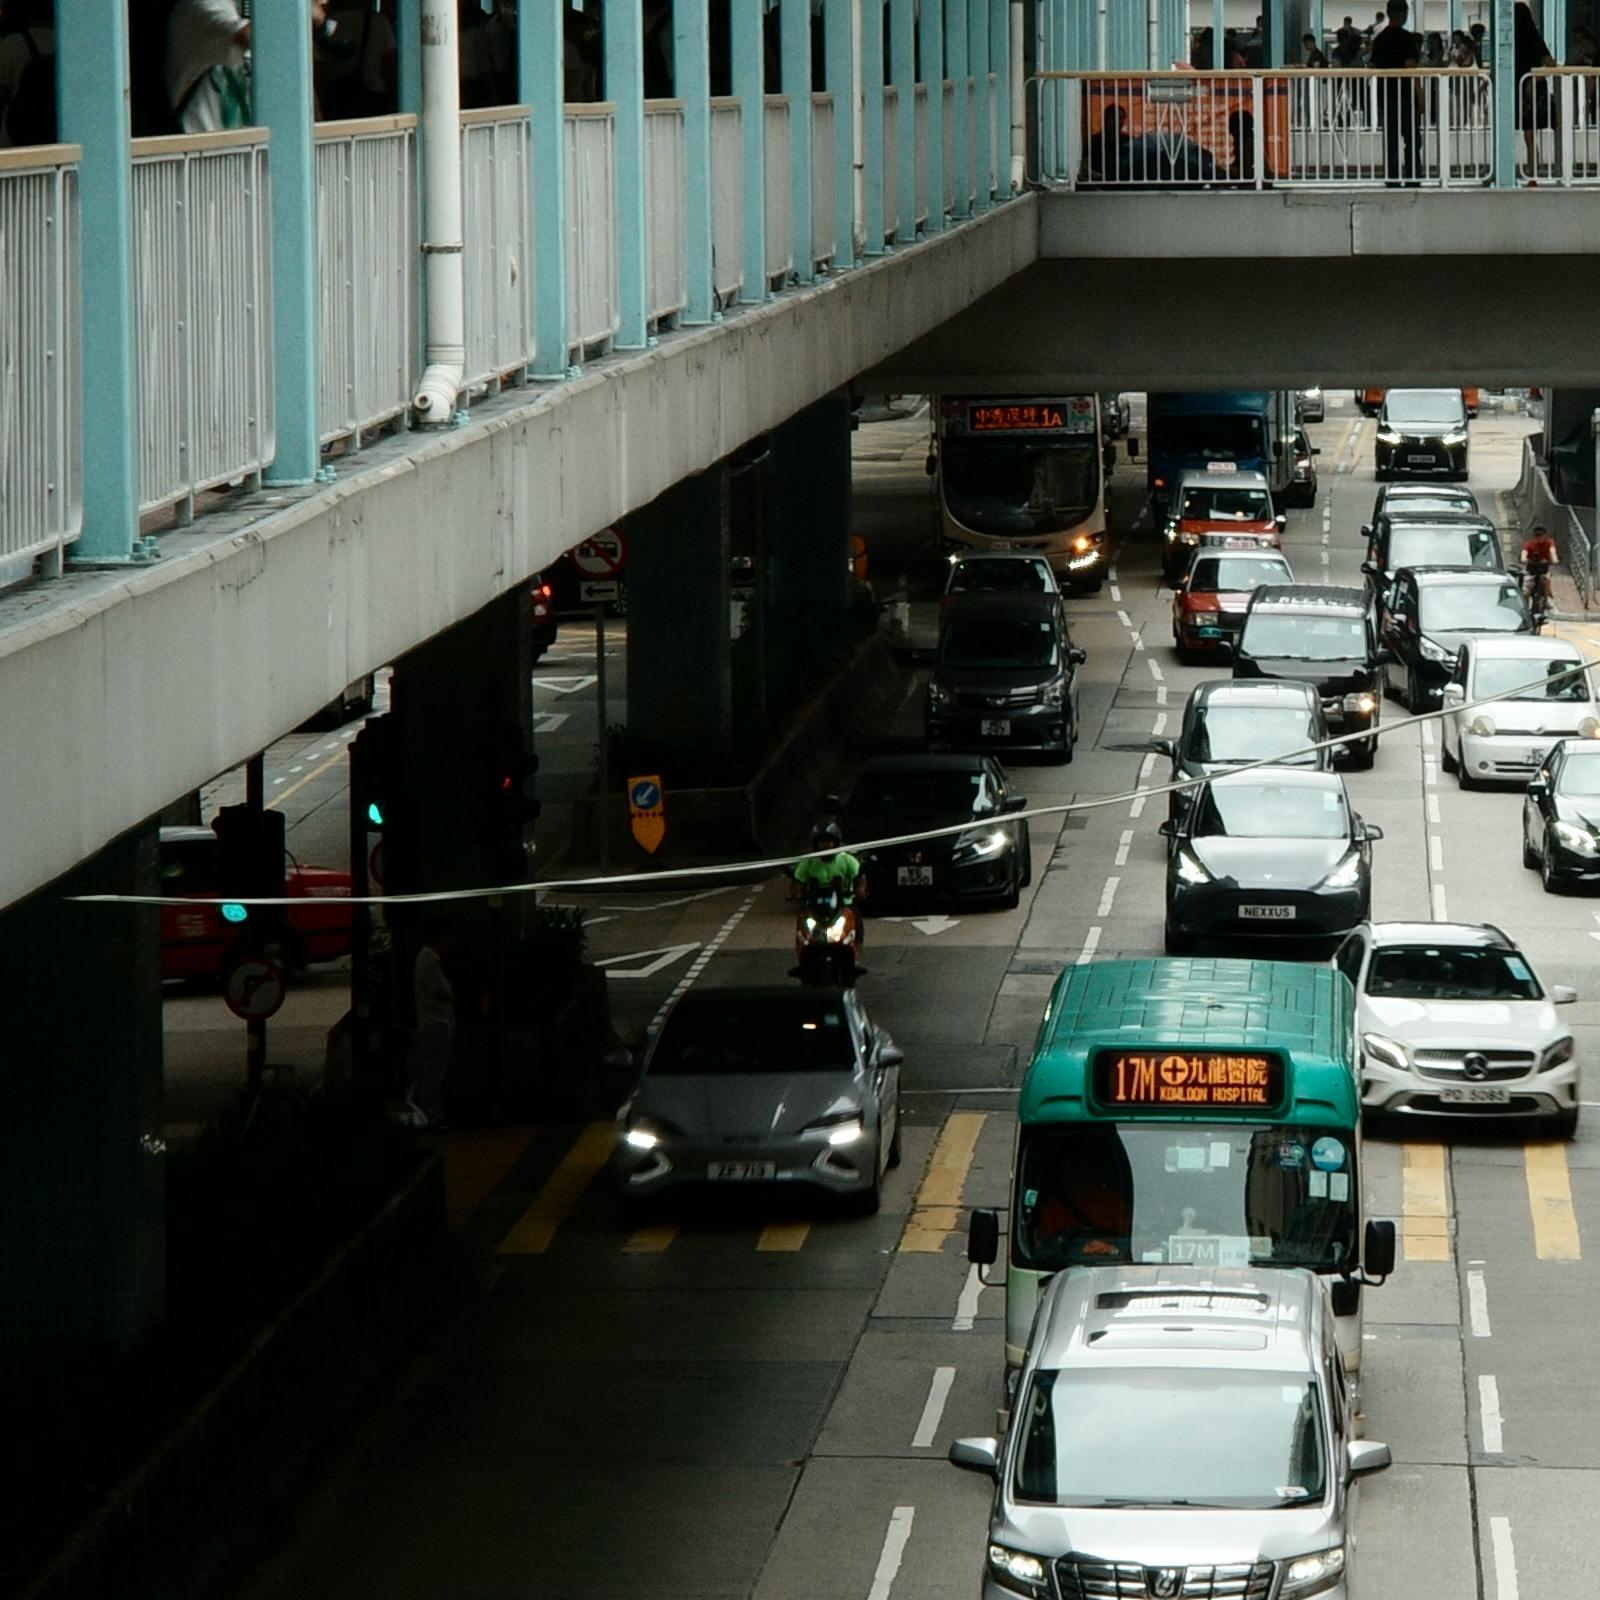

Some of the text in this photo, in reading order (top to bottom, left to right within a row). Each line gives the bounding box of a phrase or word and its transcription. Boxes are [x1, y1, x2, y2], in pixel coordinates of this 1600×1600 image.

[1243, 906, 1291, 918] NEXXUS
[1116, 1057, 1155, 1101] 17M
[1188, 1056, 1268, 1085] 九龍醫院
[1160, 1086, 1267, 1103] KOWLOON HOSPITAL
[1174, 1243, 1215, 1260] 17M
